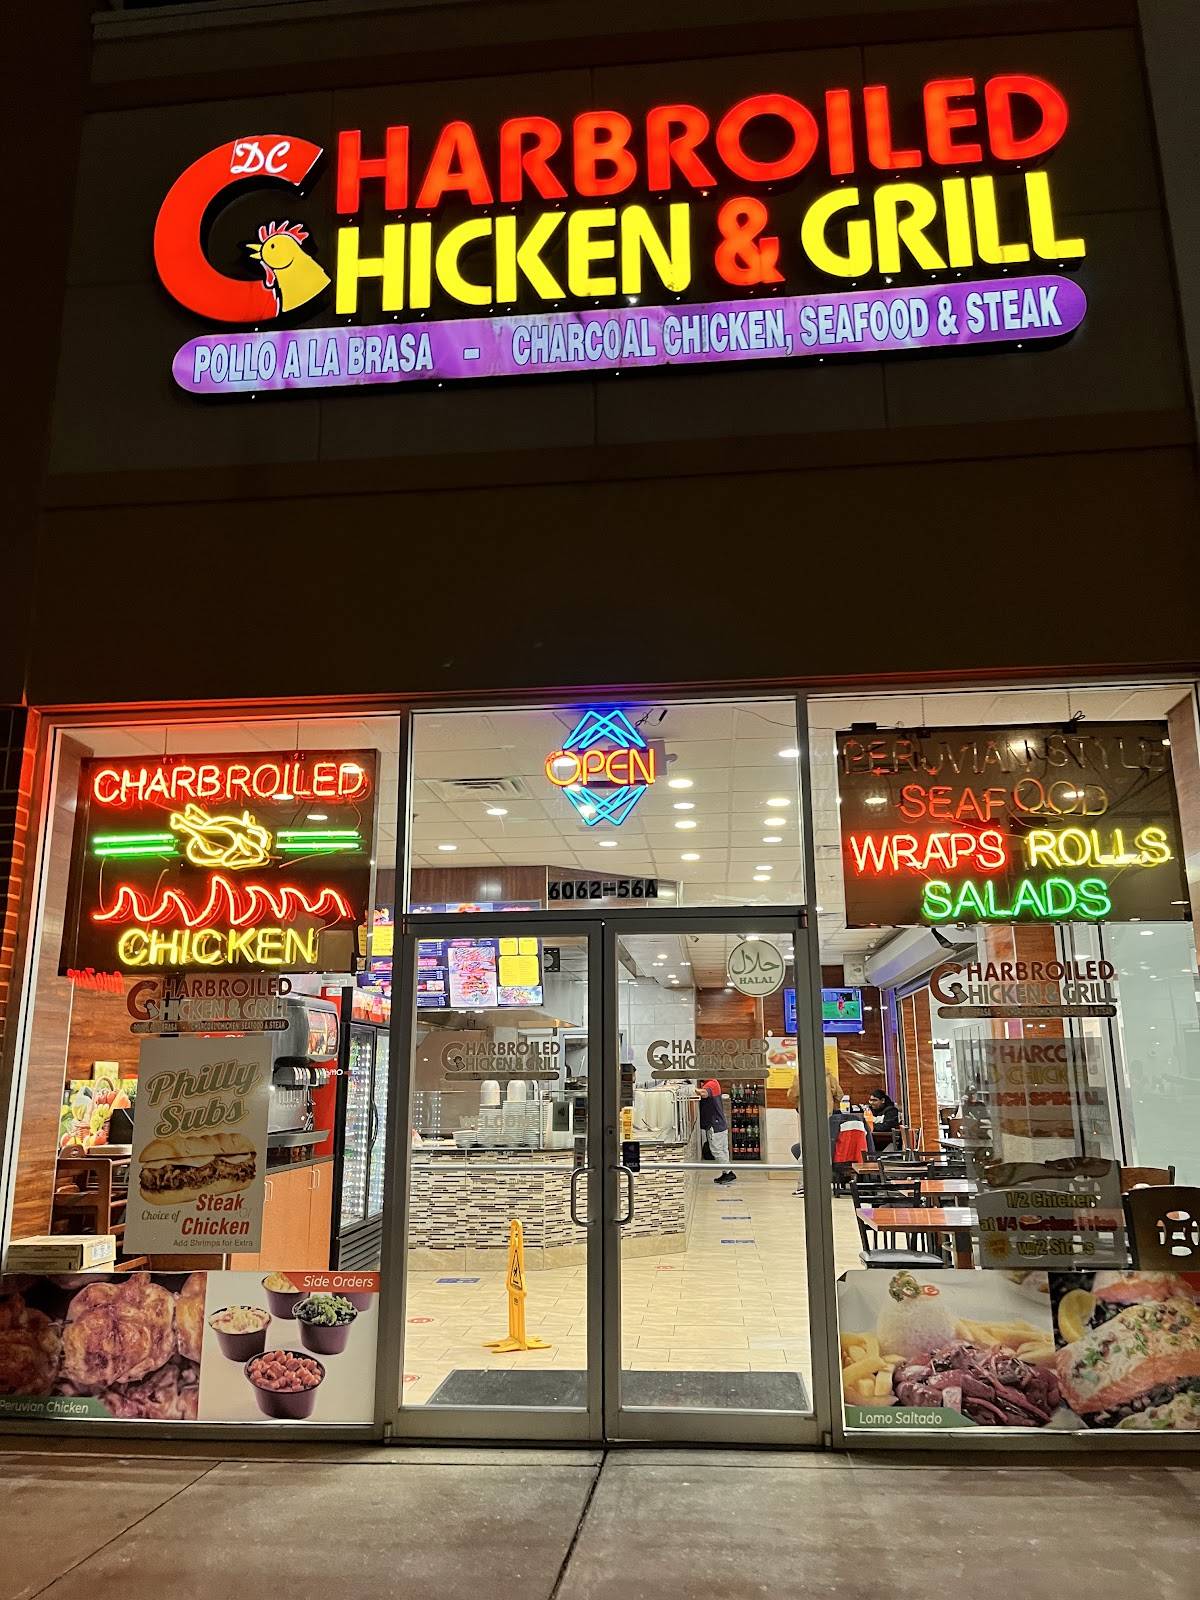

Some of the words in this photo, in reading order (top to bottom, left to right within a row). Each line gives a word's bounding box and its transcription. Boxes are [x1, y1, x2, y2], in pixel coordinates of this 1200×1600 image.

[230, 141, 290, 174] DC
[715, 197, 786, 286] &
[801, 171, 1086, 277] GRILL
[193, 341, 277, 384] POLLO
[282, 340, 301, 379] A
[308, 338, 340, 377] LA
[347, 333, 434, 375] BRASA
[511, 318, 657, 366] CHARCOAL
[662, 310, 793, 356] CHICKEN,
[800, 299, 929, 346] SEAFOOD
[937, 296, 958, 336] &
[967, 287, 1062, 333] STEAK
[545, 747, 656, 788] OPEN
[92, 761, 366, 803] CHARBROILED
[900, 778, 1109, 822] SEAFOOD
[850, 830, 1006, 873] WRAPS
[1028, 827, 1172, 867] ROLLS
[548, 880, 658, 900] 6062-56A
[921, 878, 1112, 919] SALADS
[118, 926, 316, 966] CHICKEN
[732, 950, 780, 974] حلال
[739, 976, 775, 985] HALAL
[1062, 982, 1118, 1004] GRILL
[146, 1060, 261, 1106] Philly
[154, 1096, 249, 1137] Subs
[196, 1194, 245, 1212] Steak
[1031, 1191, 1098, 1208] Chicken
[141, 1210, 170, 1220] Choice
[171, 1210, 181, 1222] of
[181, 1218, 250, 1235] Chicken
[979, 1217, 995, 1231] at
[190, 1239, 220, 1248] Shrimps
[234, 1239, 253, 1247] Extra
[304, 1275, 329, 1287] Side
[333, 1276, 374, 1288] Orders
[0, 1401, 44, 1412] Peruvian
[46, 1401, 89, 1414] Chicken
[860, 1411, 893, 1424] Lomo
[895, 1411, 943, 1424] Saltado
